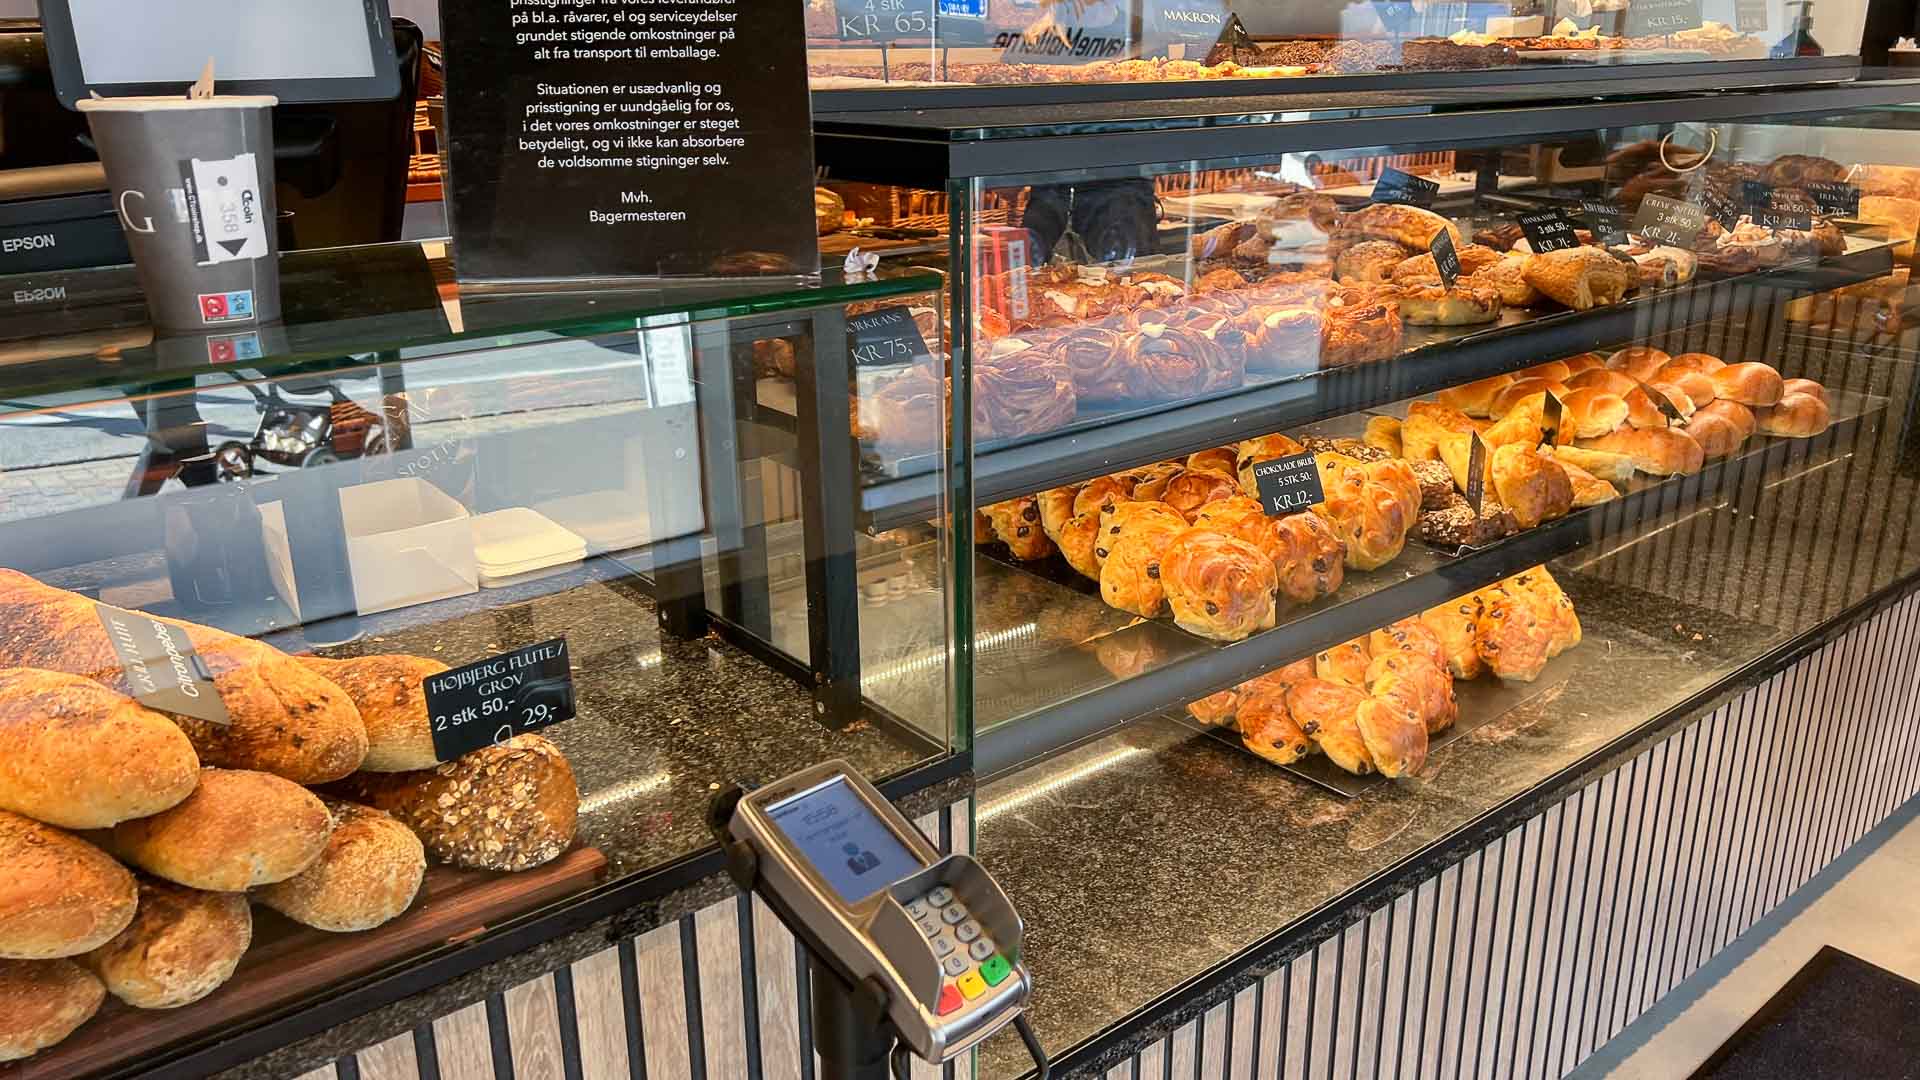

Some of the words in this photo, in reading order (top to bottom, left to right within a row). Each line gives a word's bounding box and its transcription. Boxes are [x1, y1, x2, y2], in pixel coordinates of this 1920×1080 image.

[512, 10, 528, 27] på
[532, 11, 560, 24] bl.a.
[563, 10, 610, 24] råvarer,
[613, 10, 625, 23] el
[628, 13, 646, 26] og
[649, 10, 737, 26] serviceydelser
[1164, 9, 1221, 24] MAKRON
[1647, 18, 1667, 28] KR
[841, 14, 880, 37] KR
[516, 29, 567, 44] grundet
[570, 28, 627, 43] stigende
[630, 27, 716, 43] omkostninger
[719, 27, 736, 43] på
[534, 48, 551, 60] alt
[553, 46, 571, 60] fra
[574, 46, 633, 63] transport
[634, 45, 647, 59] til
[650, 45, 721, 62] emballage.
[536, 83, 609, 96] Situationen
[612, 84, 626, 95] er
[629, 81, 701, 96] usædvanlig
[704, 84, 721, 97] og
[526, 100, 600, 117] prisstigning
[603, 102, 617, 113] er
[620, 99, 692, 115] uundgåelig
[695, 98, 712, 112] for
[715, 101, 734, 113] os,
[522, 120, 527, 132] i
[529, 119, 552, 132] det
[555, 121, 590, 133] vores
[593, 117, 681, 134] omkostninger
[683, 119, 697, 130] er
[700, 117, 740, 134] steget
[519, 138, 589, 154] betydeligt,
[592, 140, 610, 153] og
[613, 137, 624, 149] vi
[627, 136, 653, 149] ikke
[656, 135, 679, 148] kan
[682, 134, 745, 149] absorbere
[538, 156, 555, 169] de
[557, 154, 633, 169] voldsomme
[636, 153, 700, 170] stigninger
[702, 153, 729, 167] selv.
[621, 191, 653, 204] Mvh.
[119, 190, 157, 233] G
[589, 209, 686, 226] Bagermesteren
[1656, 212, 1664, 222] 3
[1664, 213, 1679, 224] stk
[1763, 214, 1780, 226] KR
[1641, 225, 1660, 240] KR
[2, 233, 56, 252] EPSON
[851, 343, 885, 364] KR
[1278, 477, 1284, 487] 5
[1283, 474, 1300, 486] STK
[1273, 494, 1296, 511] KR
[478, 671, 524, 697] GROV
[435, 715, 448, 732] 2
[451, 706, 479, 726] stk
[481, 697, 516, 716] 50,-
[521, 702, 558, 727] 29,-
